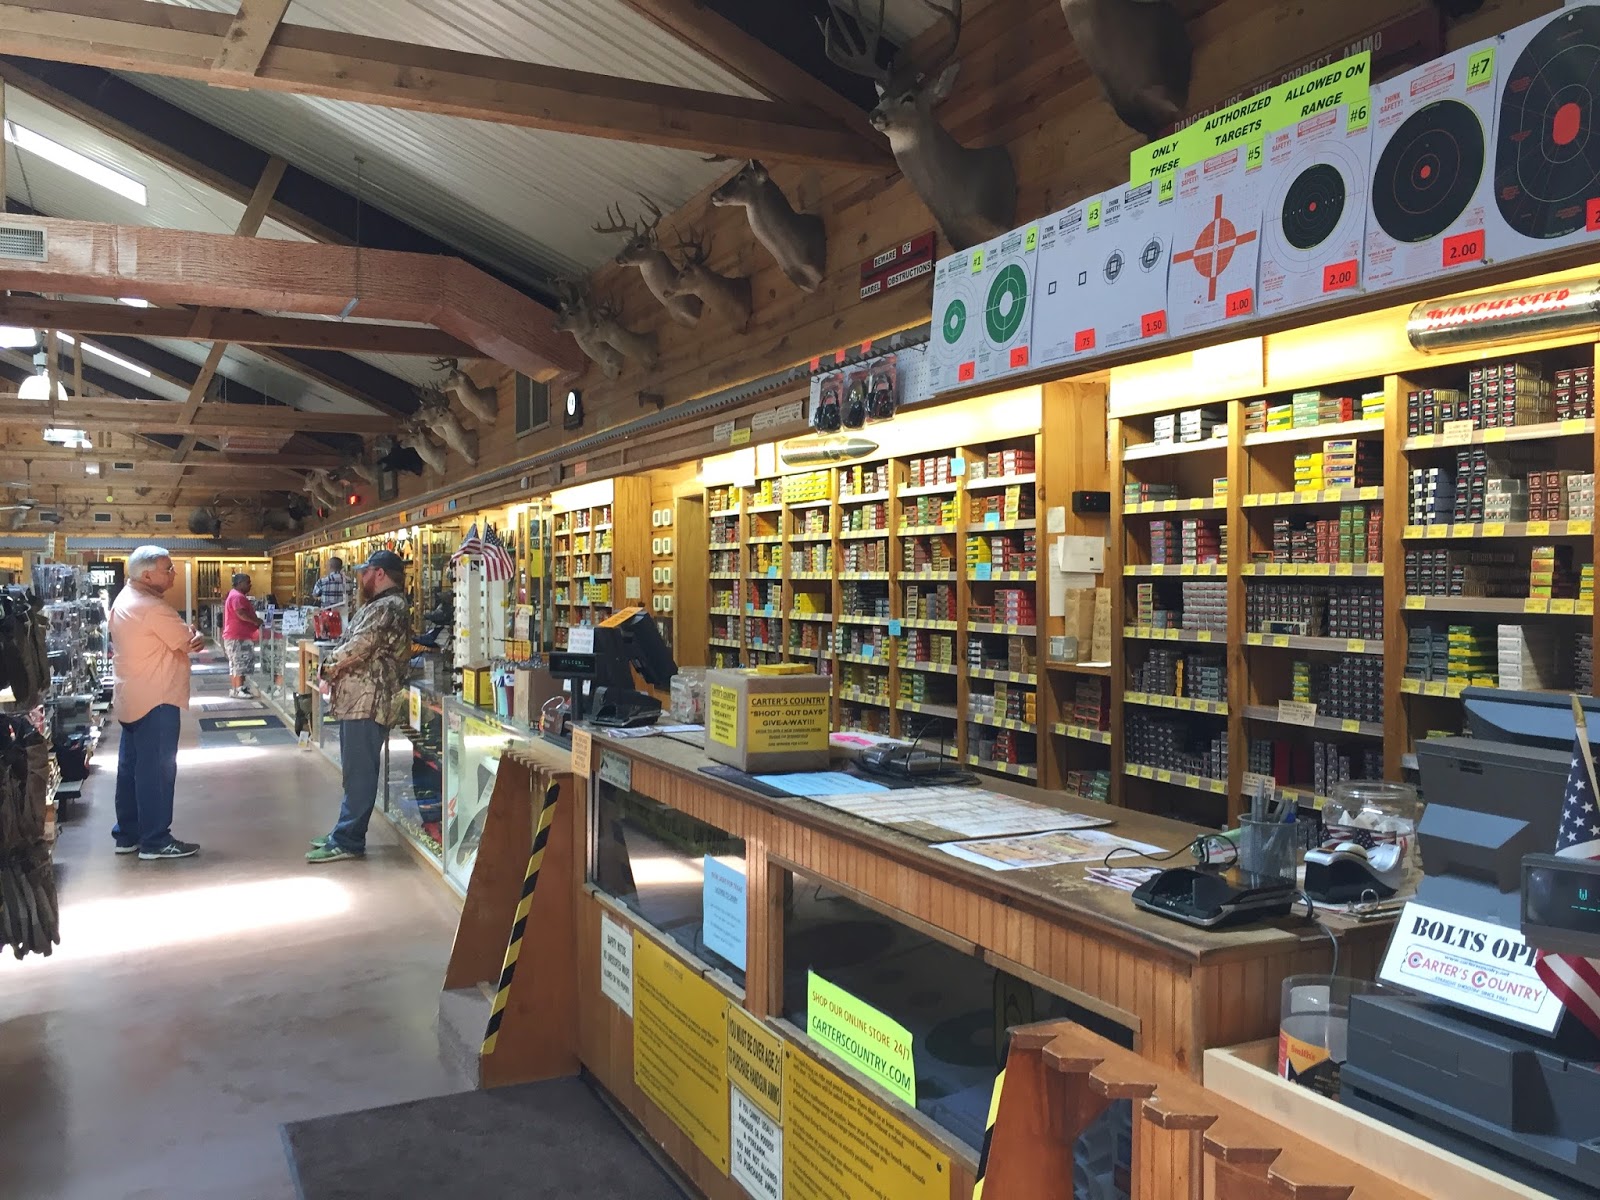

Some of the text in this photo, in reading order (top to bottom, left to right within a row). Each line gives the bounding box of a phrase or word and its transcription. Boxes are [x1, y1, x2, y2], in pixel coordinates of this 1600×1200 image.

[1471, 58, 1489, 77] #7
[1204, 96, 1271, 132] AUTHORIZED
[1285, 71, 1342, 102] ALLOWED
[1345, 63, 1365, 79] ON
[1350, 105, 1367, 122] #6
[1150, 158, 1180, 177] THESE
[1215, 120, 1262, 146] TARGETS
[1300, 92, 1343, 117] RANGE
[1152, 141, 1179, 159] ONLY
[1248, 146, 1260, 161] #5
[1161, 180, 1172, 194] #4
[1089, 209, 1098, 220] #3
[1026, 233, 1035, 243] #2
[875, 242, 910, 267] BEWARE OF
[1450, 243, 1477, 259] 2.00
[973, 256, 981, 266] #1
[861, 283, 880, 296] BARREL
[888, 261, 931, 285] OBSTRUCTIONS
[1329, 270, 1351, 285] 2.00
[1231, 298, 1249, 311] 1.00
[1426, 288, 1570, 331] WINCHESTER
[1146, 319, 1163, 332] 1.50
[752, 697, 825, 705] CARTER'S COUNTRY
[1411, 916, 1487, 953] BOLTS
[1407, 951, 1543, 1002] CARTER'S COUNTRY
[812, 990, 909, 1061] SHOP OUR ONLINE STORE 24/7
[747, 1031, 751, 1054] BE
[752, 1036, 764, 1064] OVER
[765, 1045, 774, 1072] AGE
[775, 1053, 780, 1076] 21
[812, 1015, 911, 1091] CARTERSCOUNTRY.COM
[737, 1150, 742, 1165] TO
